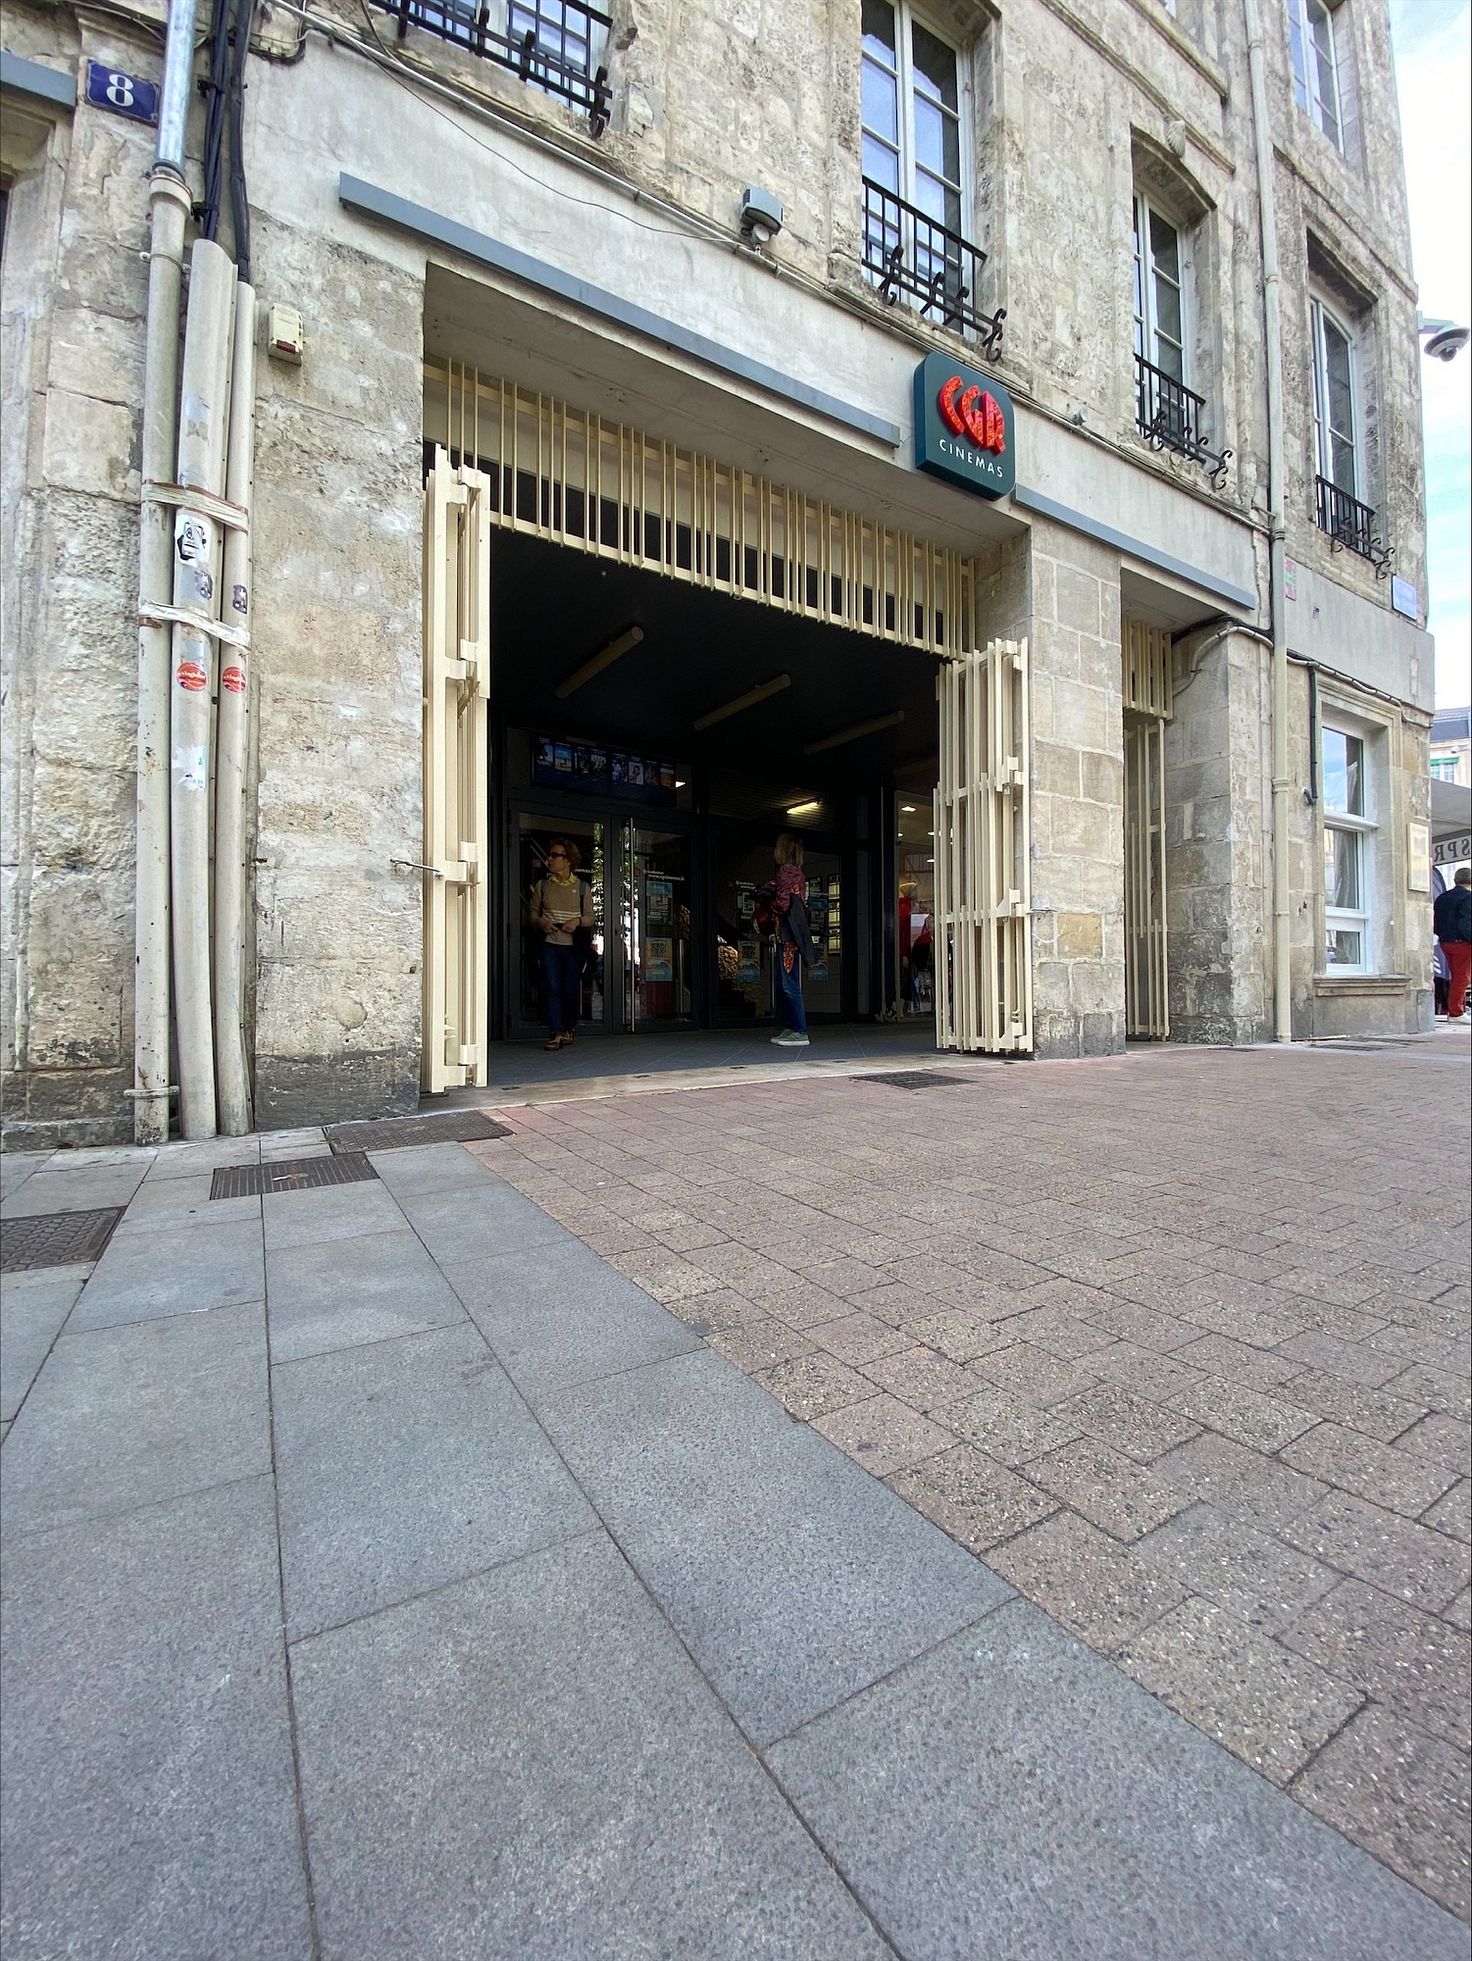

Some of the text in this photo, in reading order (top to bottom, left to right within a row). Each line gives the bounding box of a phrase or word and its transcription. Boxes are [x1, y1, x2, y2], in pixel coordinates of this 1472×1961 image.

[106, 74, 134, 107] 8
[940, 376, 1006, 453] CGR
[939, 439, 1003, 478] CINEMAS
